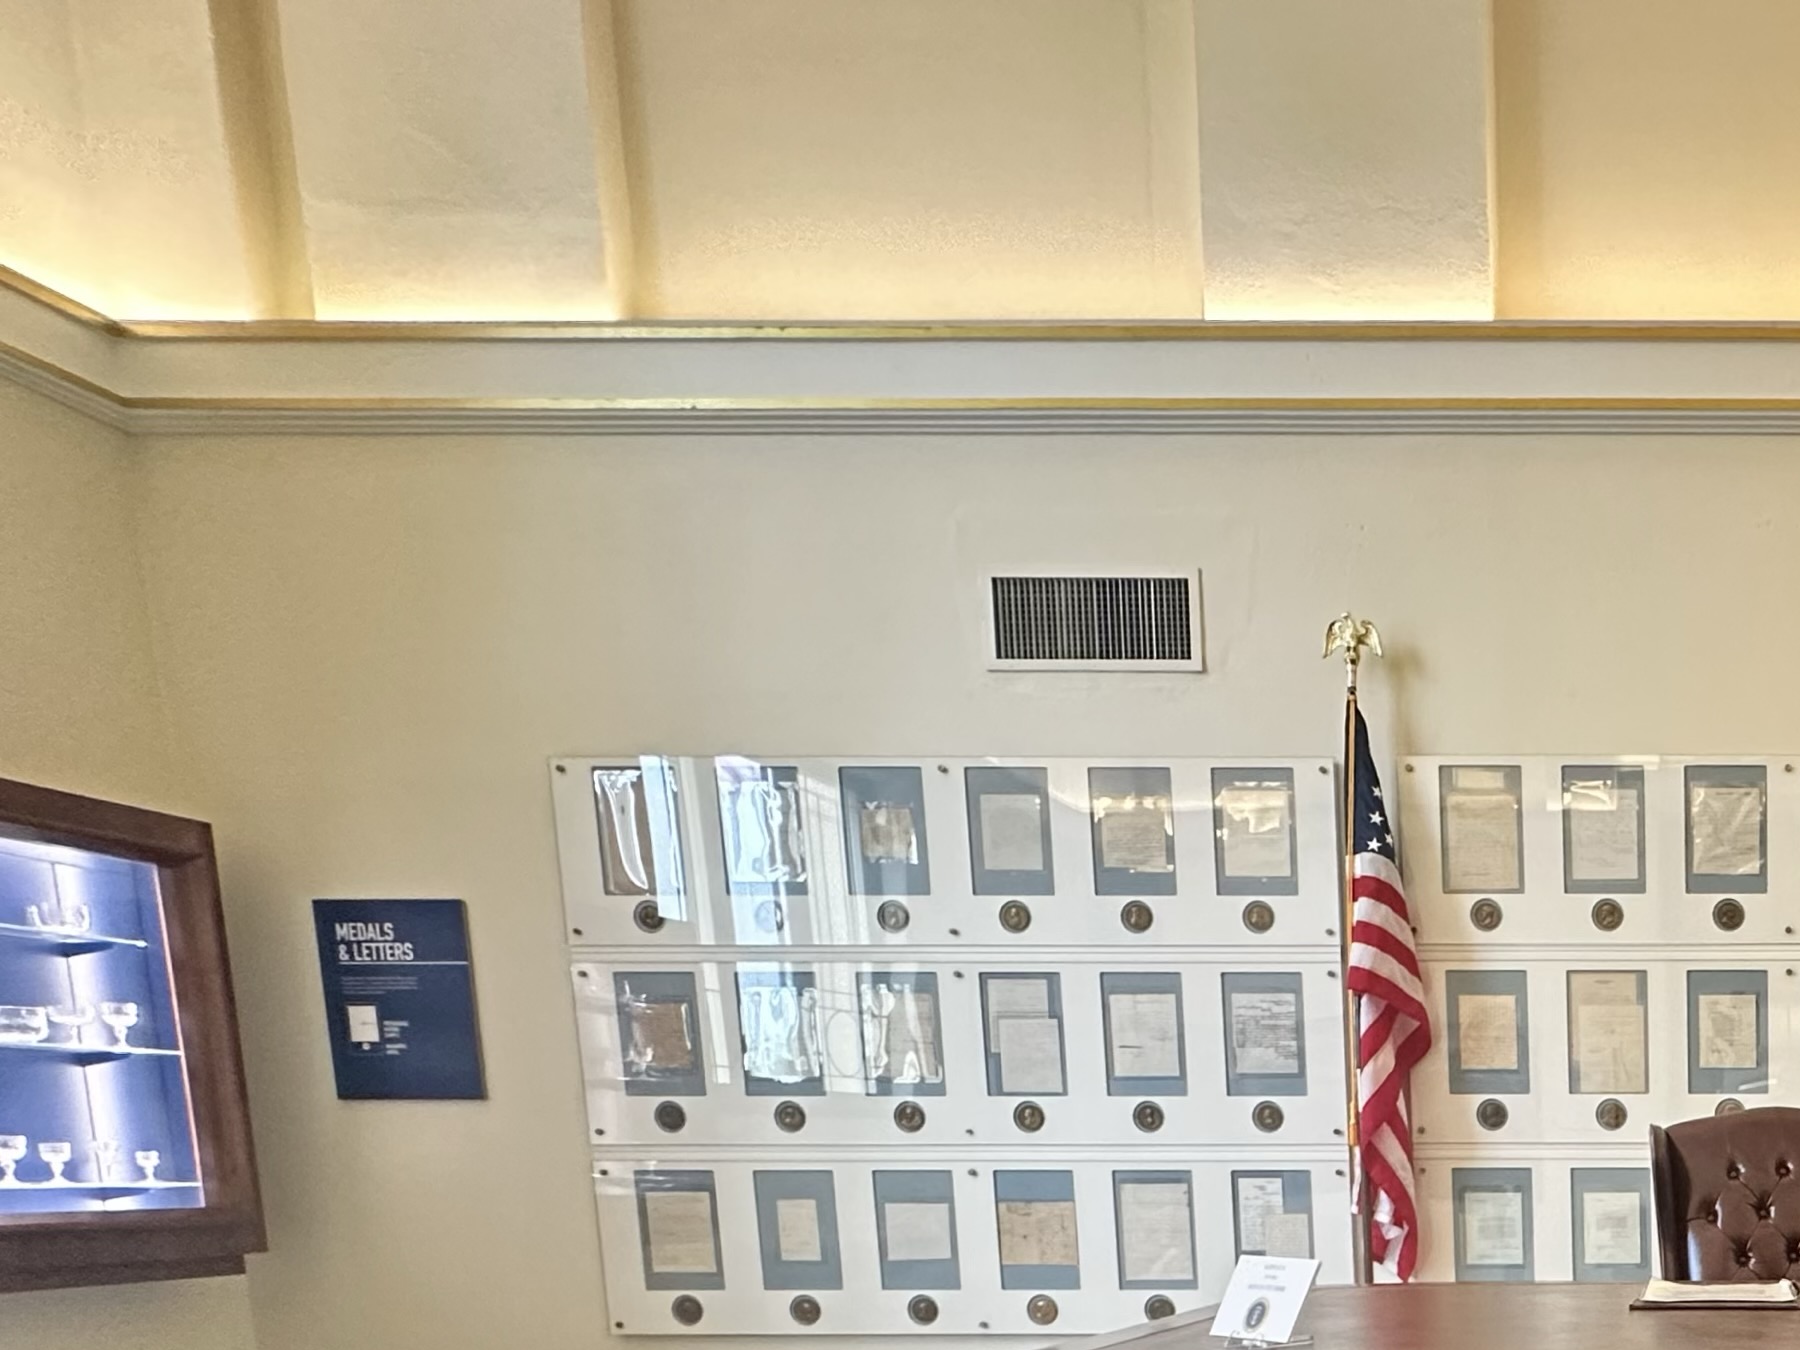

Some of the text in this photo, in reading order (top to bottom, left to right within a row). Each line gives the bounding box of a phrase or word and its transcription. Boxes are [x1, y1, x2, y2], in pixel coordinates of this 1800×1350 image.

[335, 922, 394, 941] MEDALS
[338, 942, 414, 961] & LETTERS
